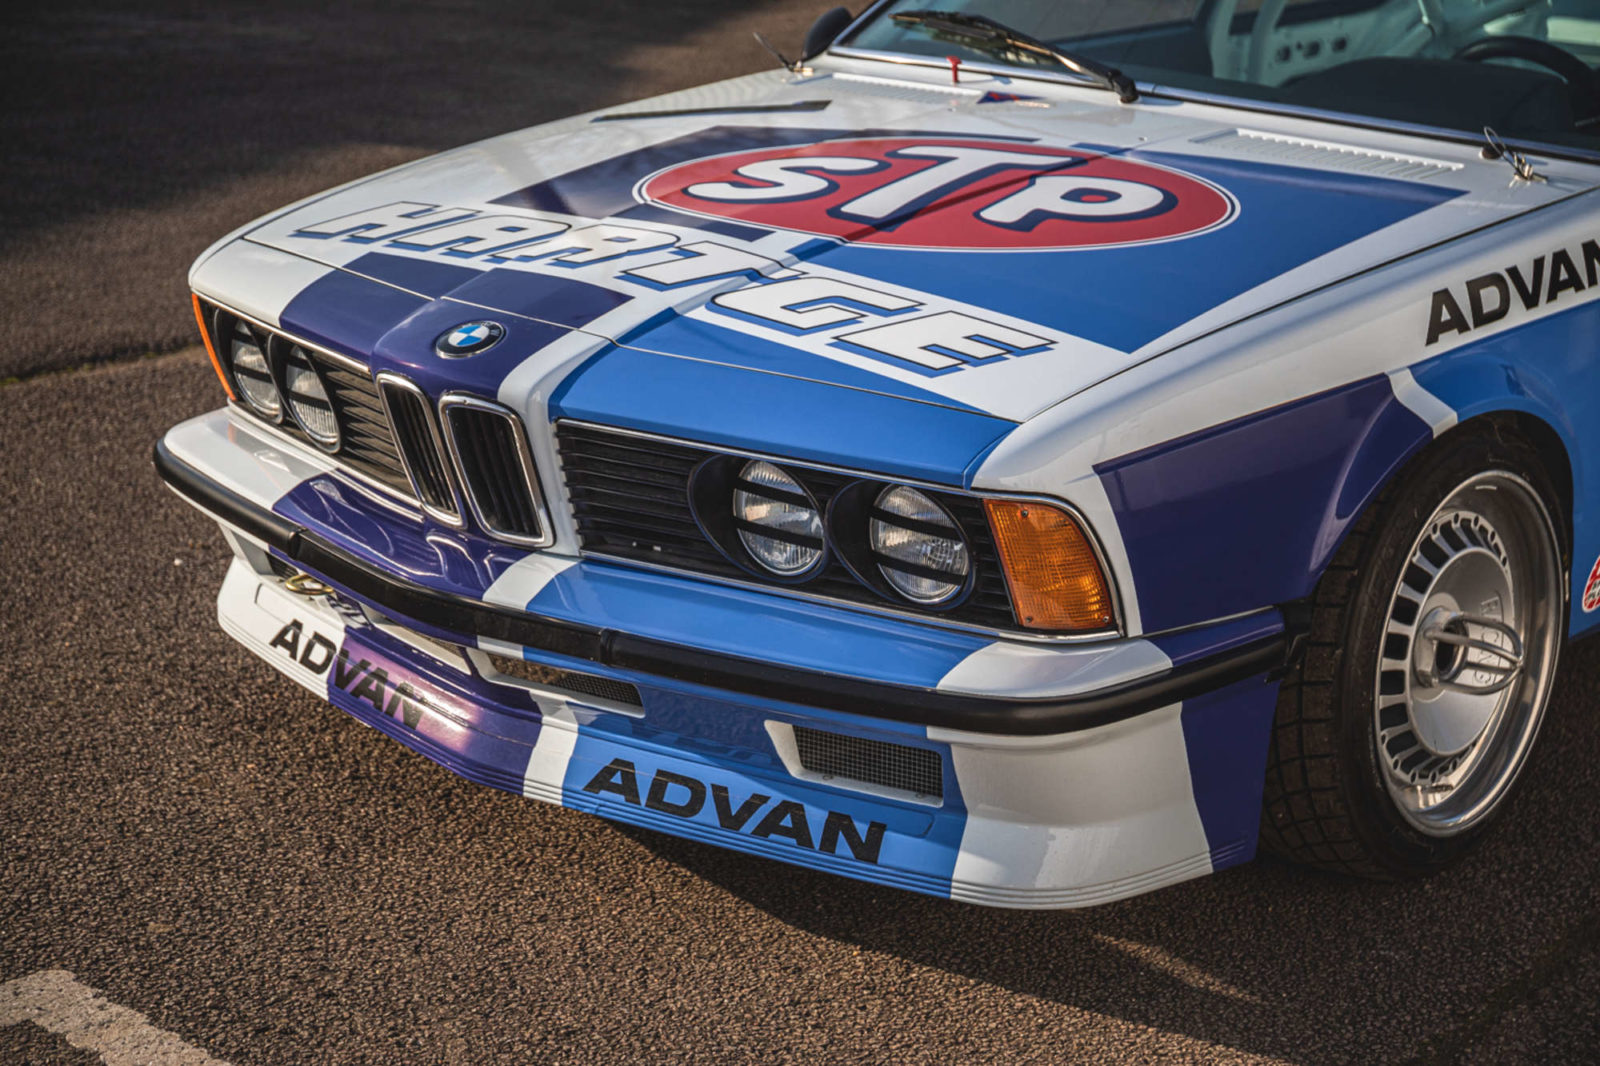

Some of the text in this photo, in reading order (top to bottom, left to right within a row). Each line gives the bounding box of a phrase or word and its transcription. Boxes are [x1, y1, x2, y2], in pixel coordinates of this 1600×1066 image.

[681, 144, 1179, 232] STP
[288, 200, 1060, 378] HARTGE
[269, 618, 428, 731] ADVAN
[582, 757, 887, 865] ADVAN
